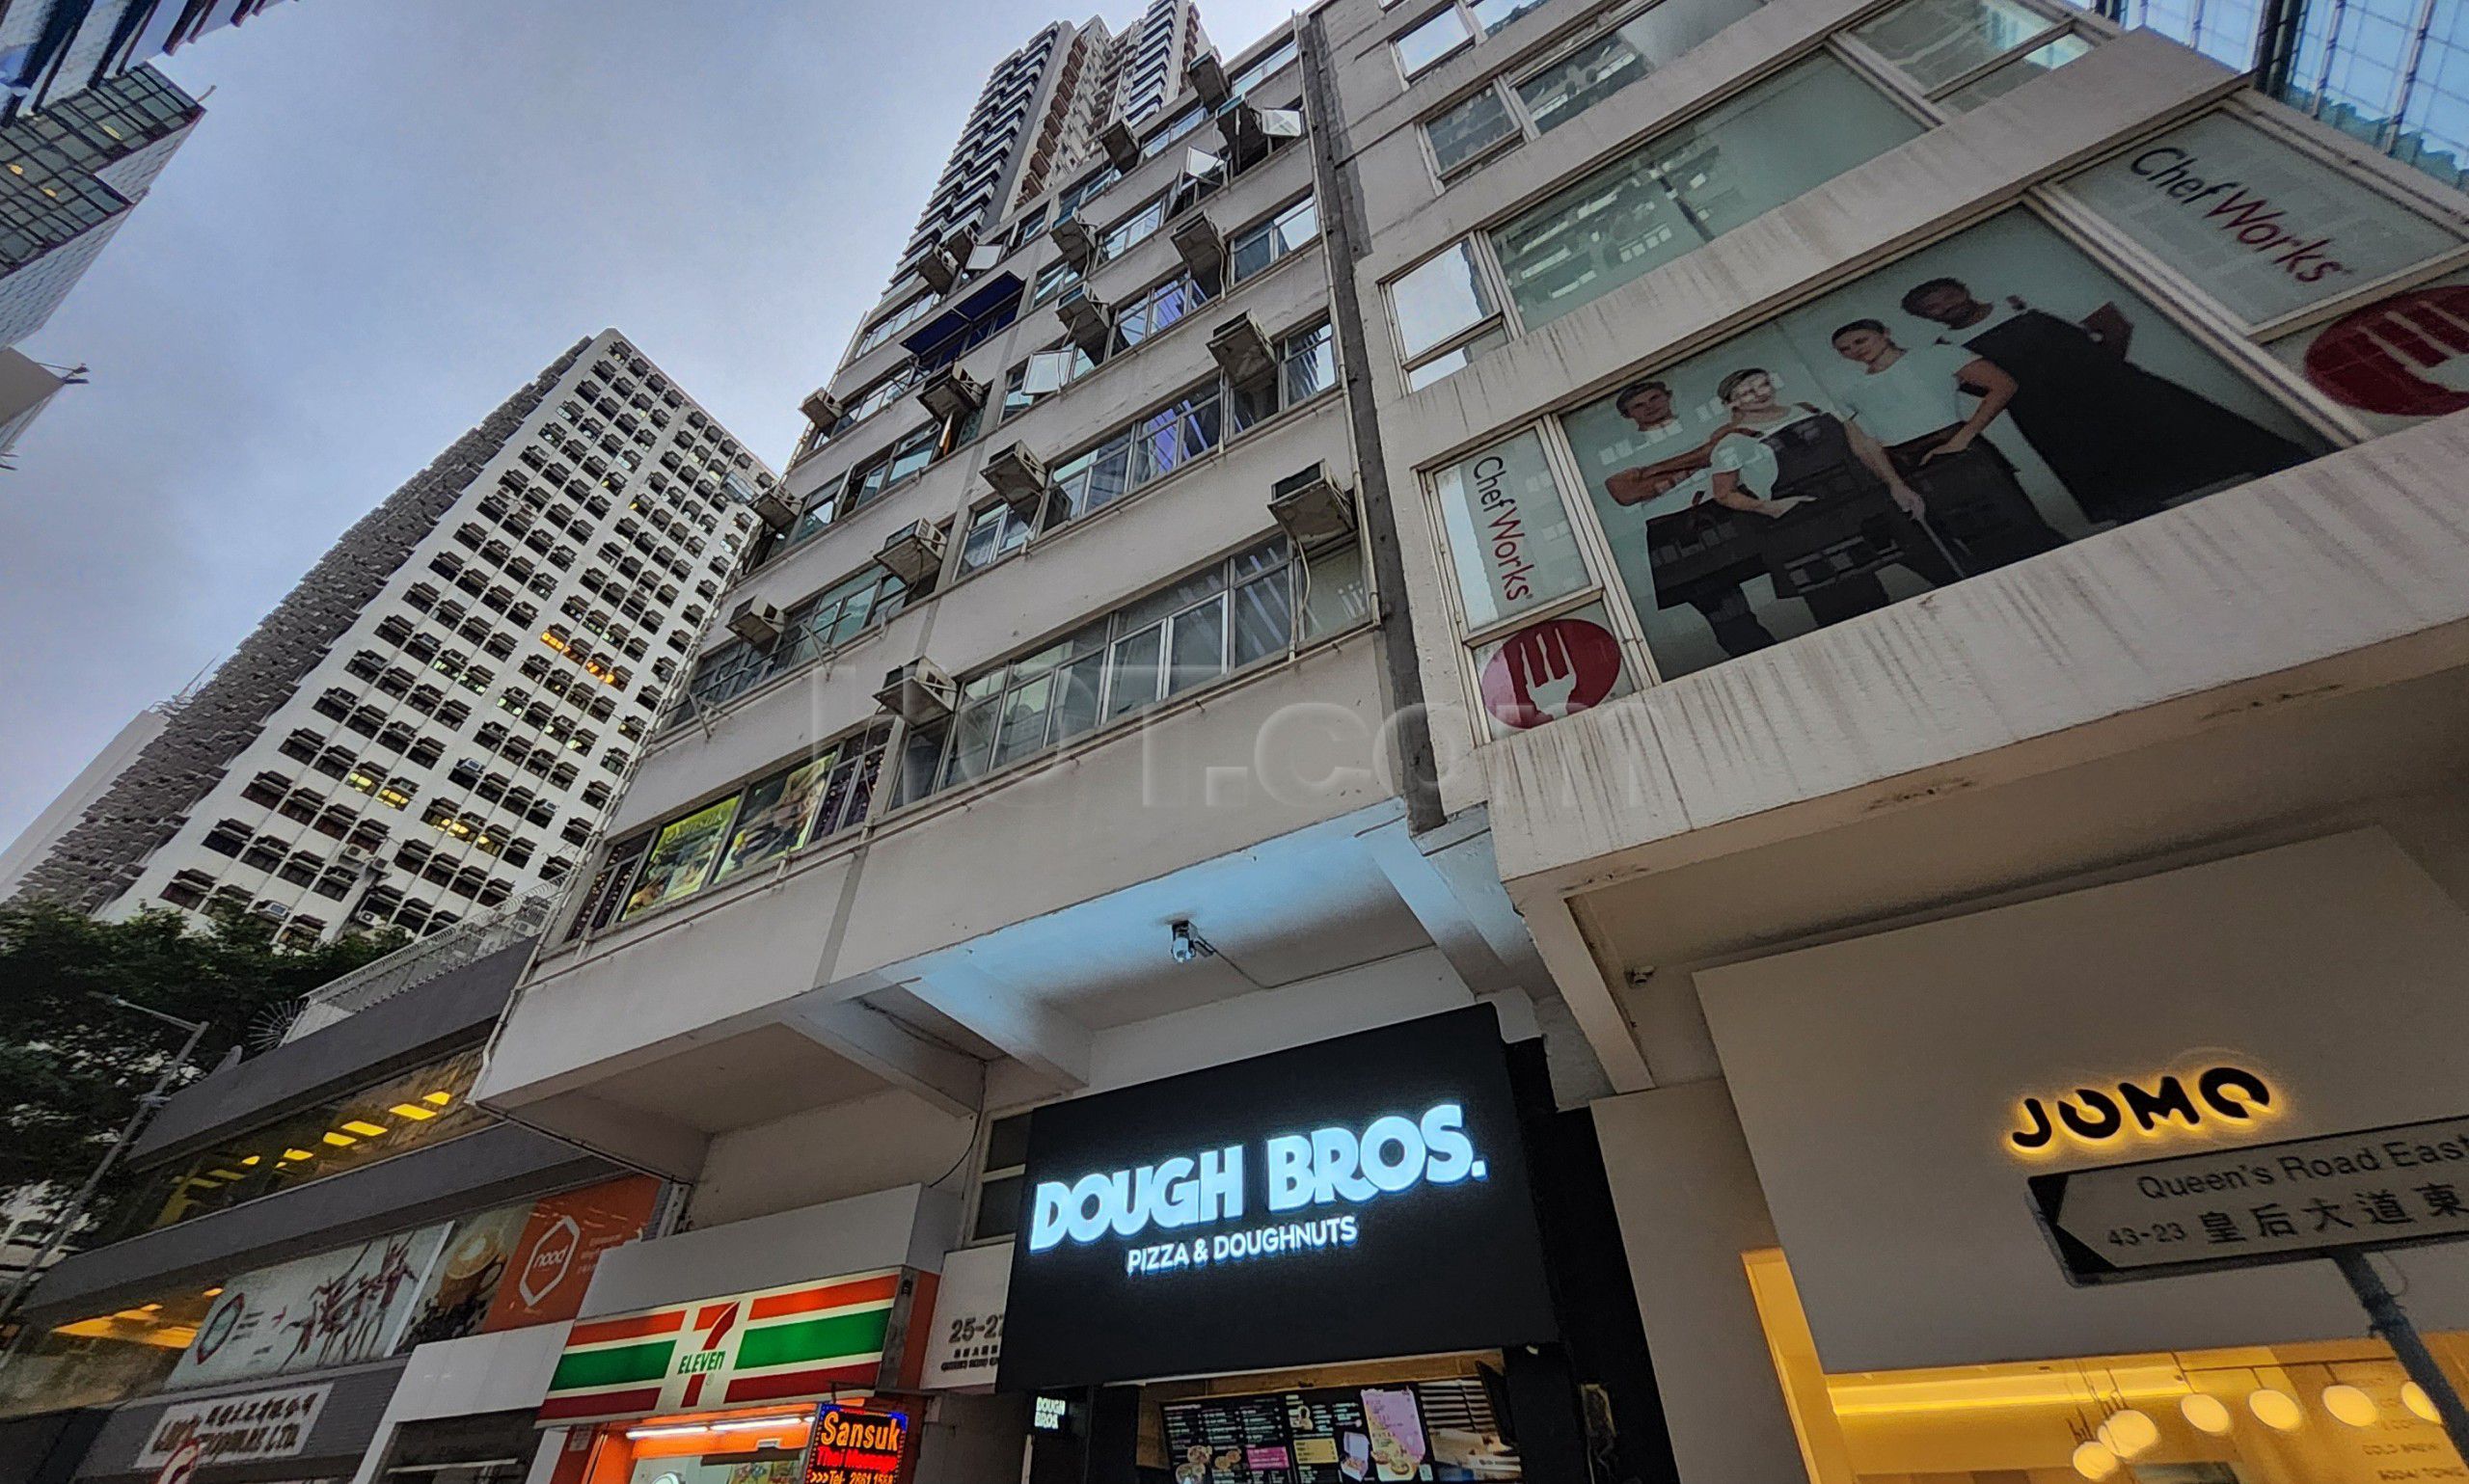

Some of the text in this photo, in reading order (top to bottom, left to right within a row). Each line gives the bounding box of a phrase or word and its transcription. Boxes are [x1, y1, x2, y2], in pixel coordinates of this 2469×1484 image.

[1030, 1104, 1487, 1254] DOUGH BROS.
[2137, 1164, 2274, 1200] Queen's
[2277, 1147, 2381, 1182] Road
[2108, 1222, 2187, 1247] 43-23
[2198, 1182, 2469, 1244] 皇后大道東
[1126, 1215, 1360, 1278] PIZZA & DOUGHNUTS
[821, 1411, 900, 1451] Sansuk
[1036, 1396, 1066, 1416] DOUGH
